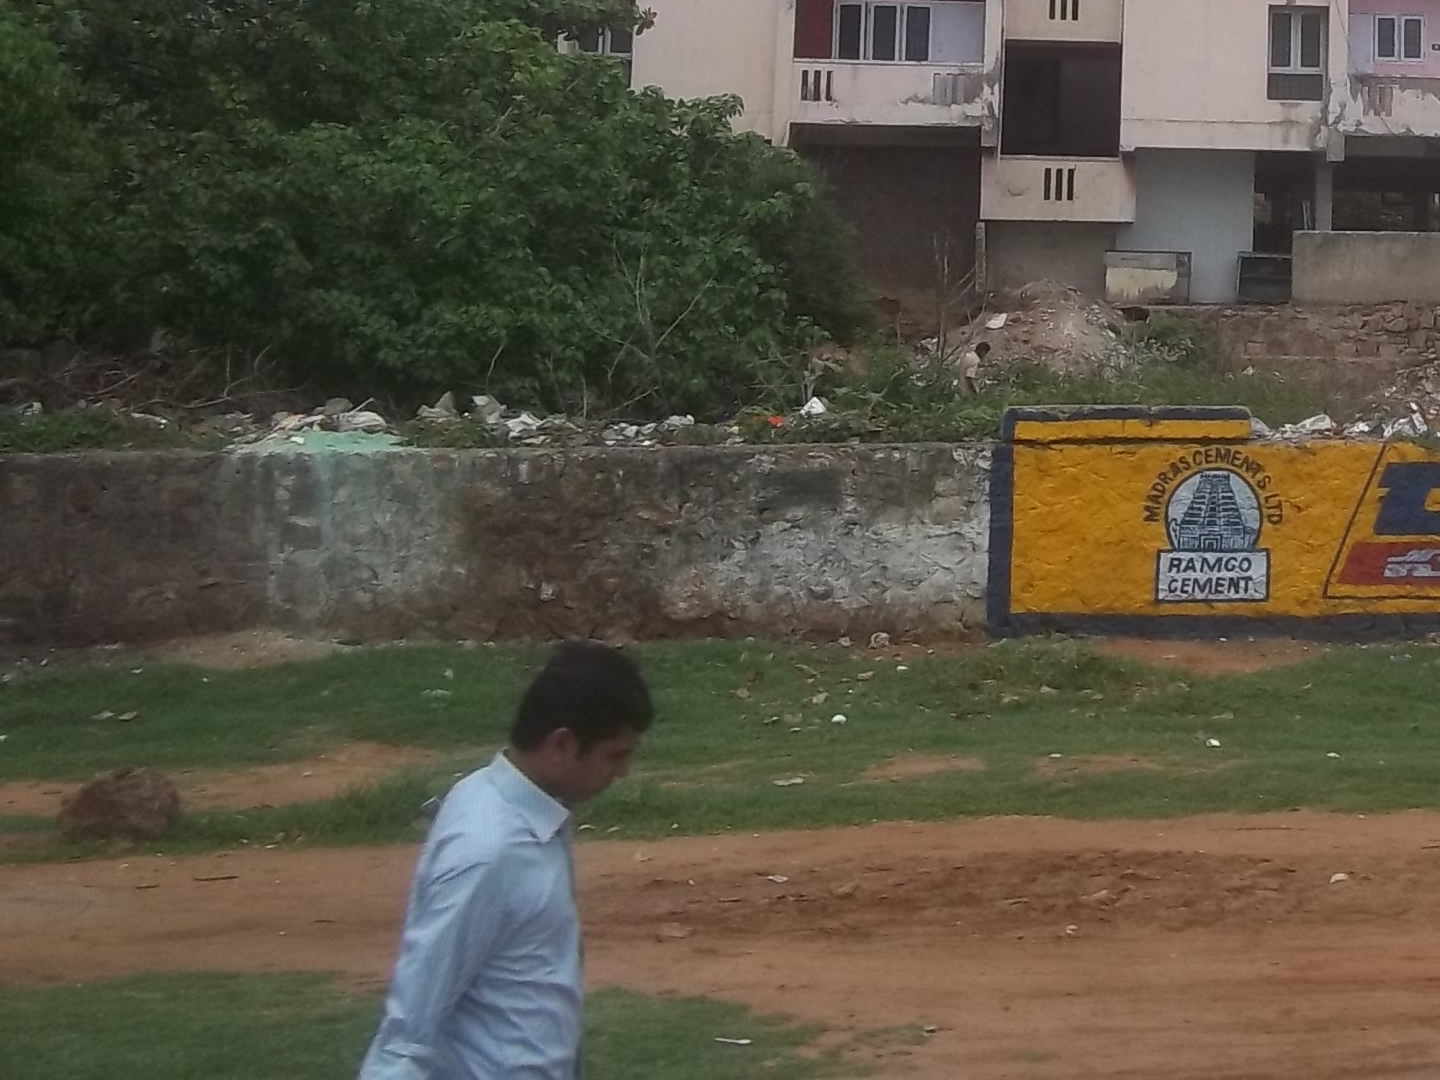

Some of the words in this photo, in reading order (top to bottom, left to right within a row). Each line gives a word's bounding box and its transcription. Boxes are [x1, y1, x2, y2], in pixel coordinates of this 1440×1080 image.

[1142, 455, 1192, 523] MADRAS
[1192, 447, 1272, 491] CEMENTS
[1264, 493, 1283, 526] LTD
[1167, 576, 1254, 595] CEMENT
